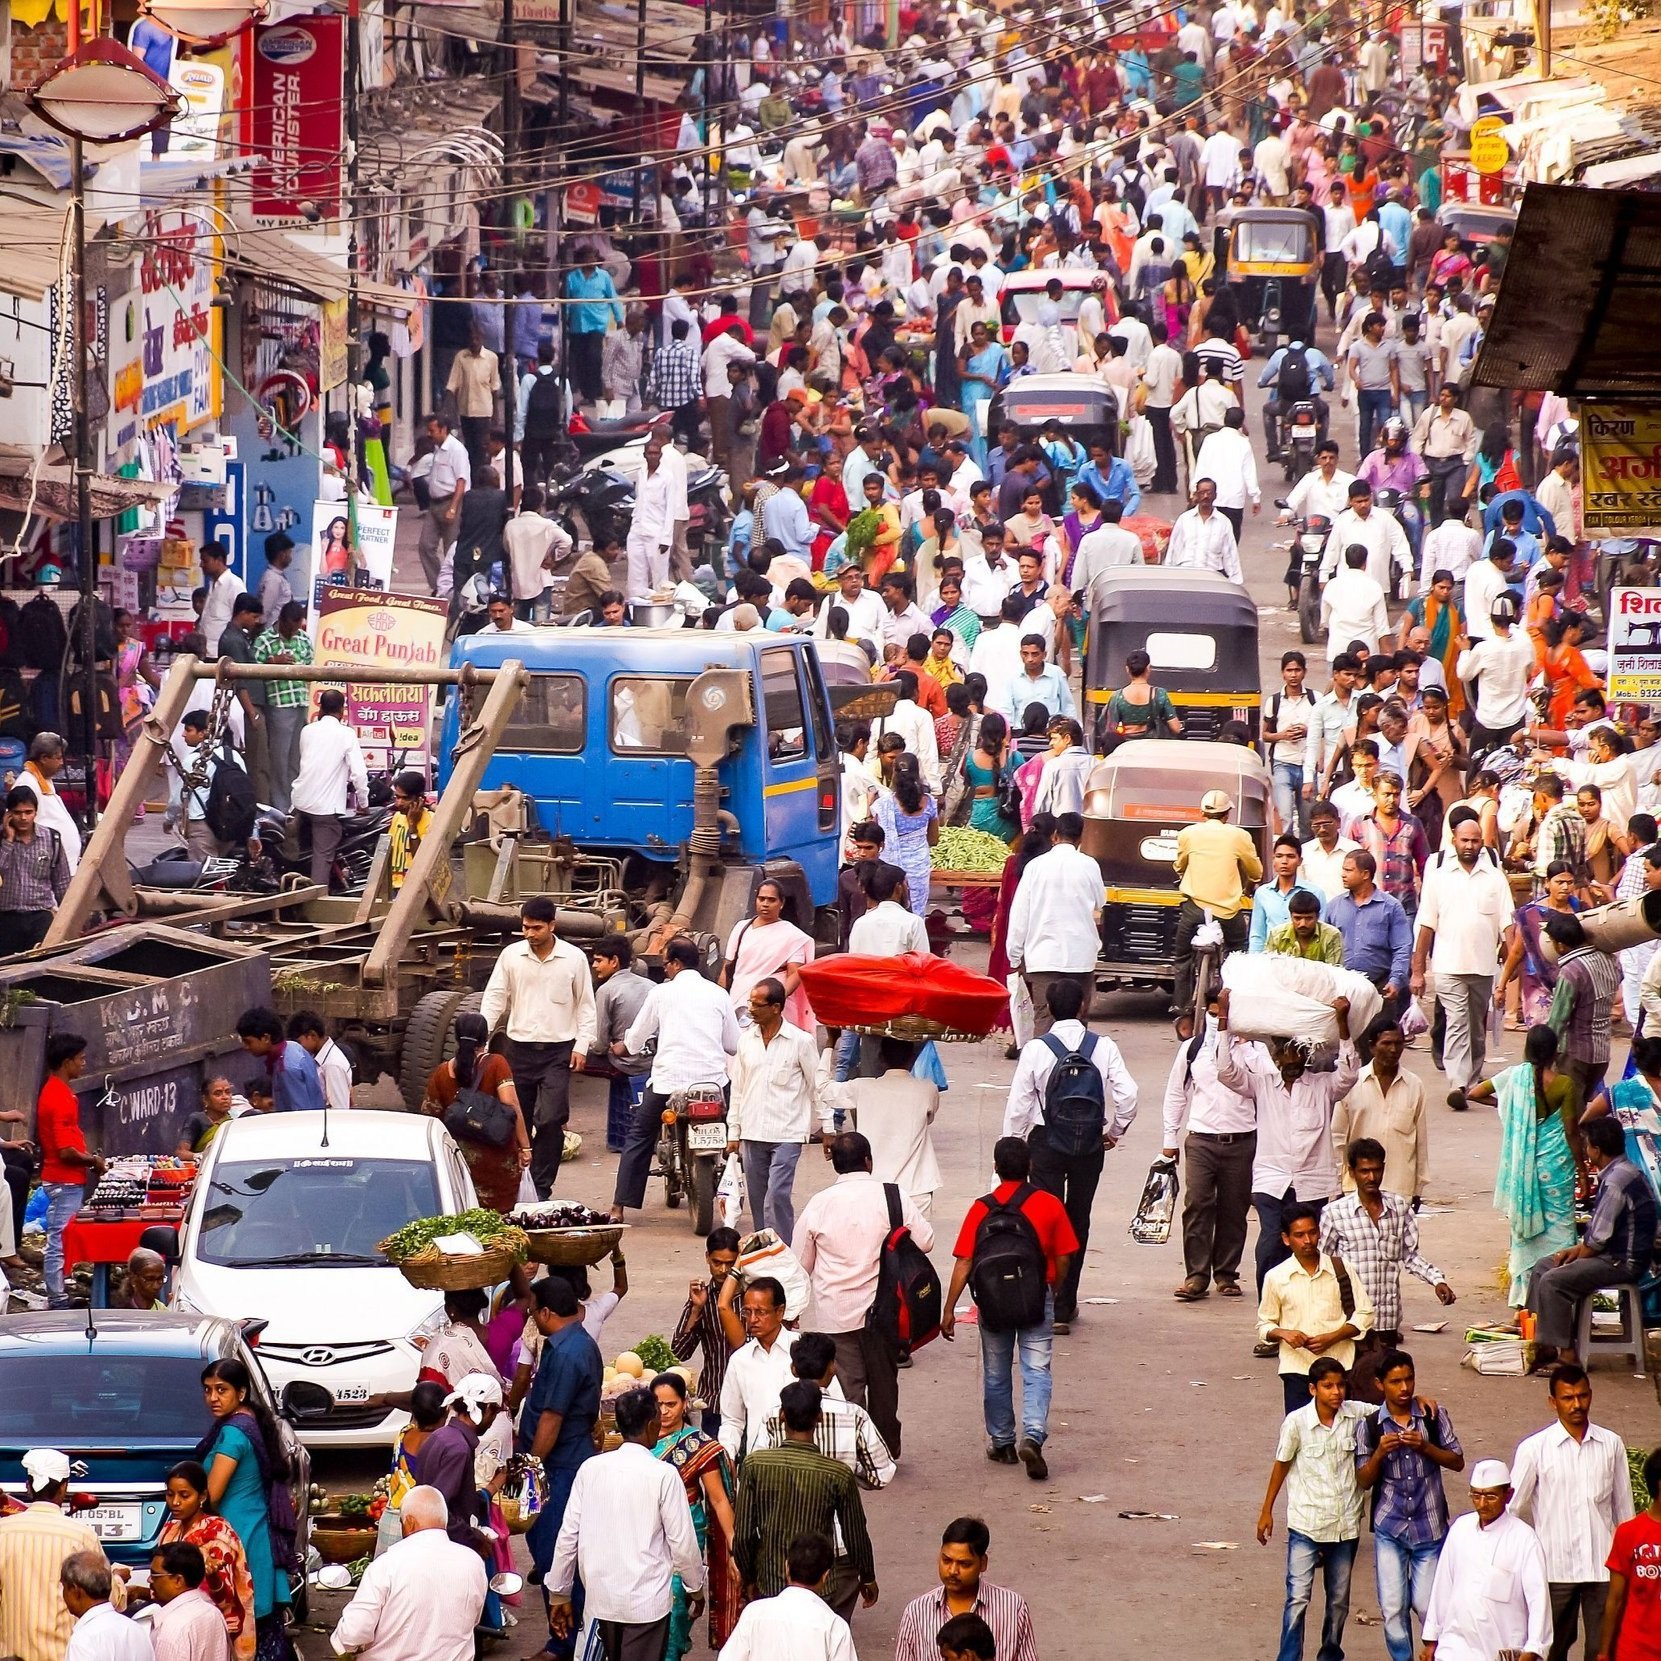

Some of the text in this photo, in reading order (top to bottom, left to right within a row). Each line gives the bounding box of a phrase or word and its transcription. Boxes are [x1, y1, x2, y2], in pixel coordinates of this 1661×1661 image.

[271, 72, 286, 199] AMERICAN
[256, 219, 275, 228] MY
[1587, 414, 1636, 436] किरण
[1589, 492, 1634, 507] रबर
[357, 525, 390, 536] PERFECT
[328, 589, 354, 600] Great
[386, 596, 412, 607] Great
[321, 628, 437, 667] Great Punjab
[1617, 657, 1636, 673] जुनी
[357, 706, 420, 723] बॅग हाऊस
[335, 1388, 368, 1400] 4523
